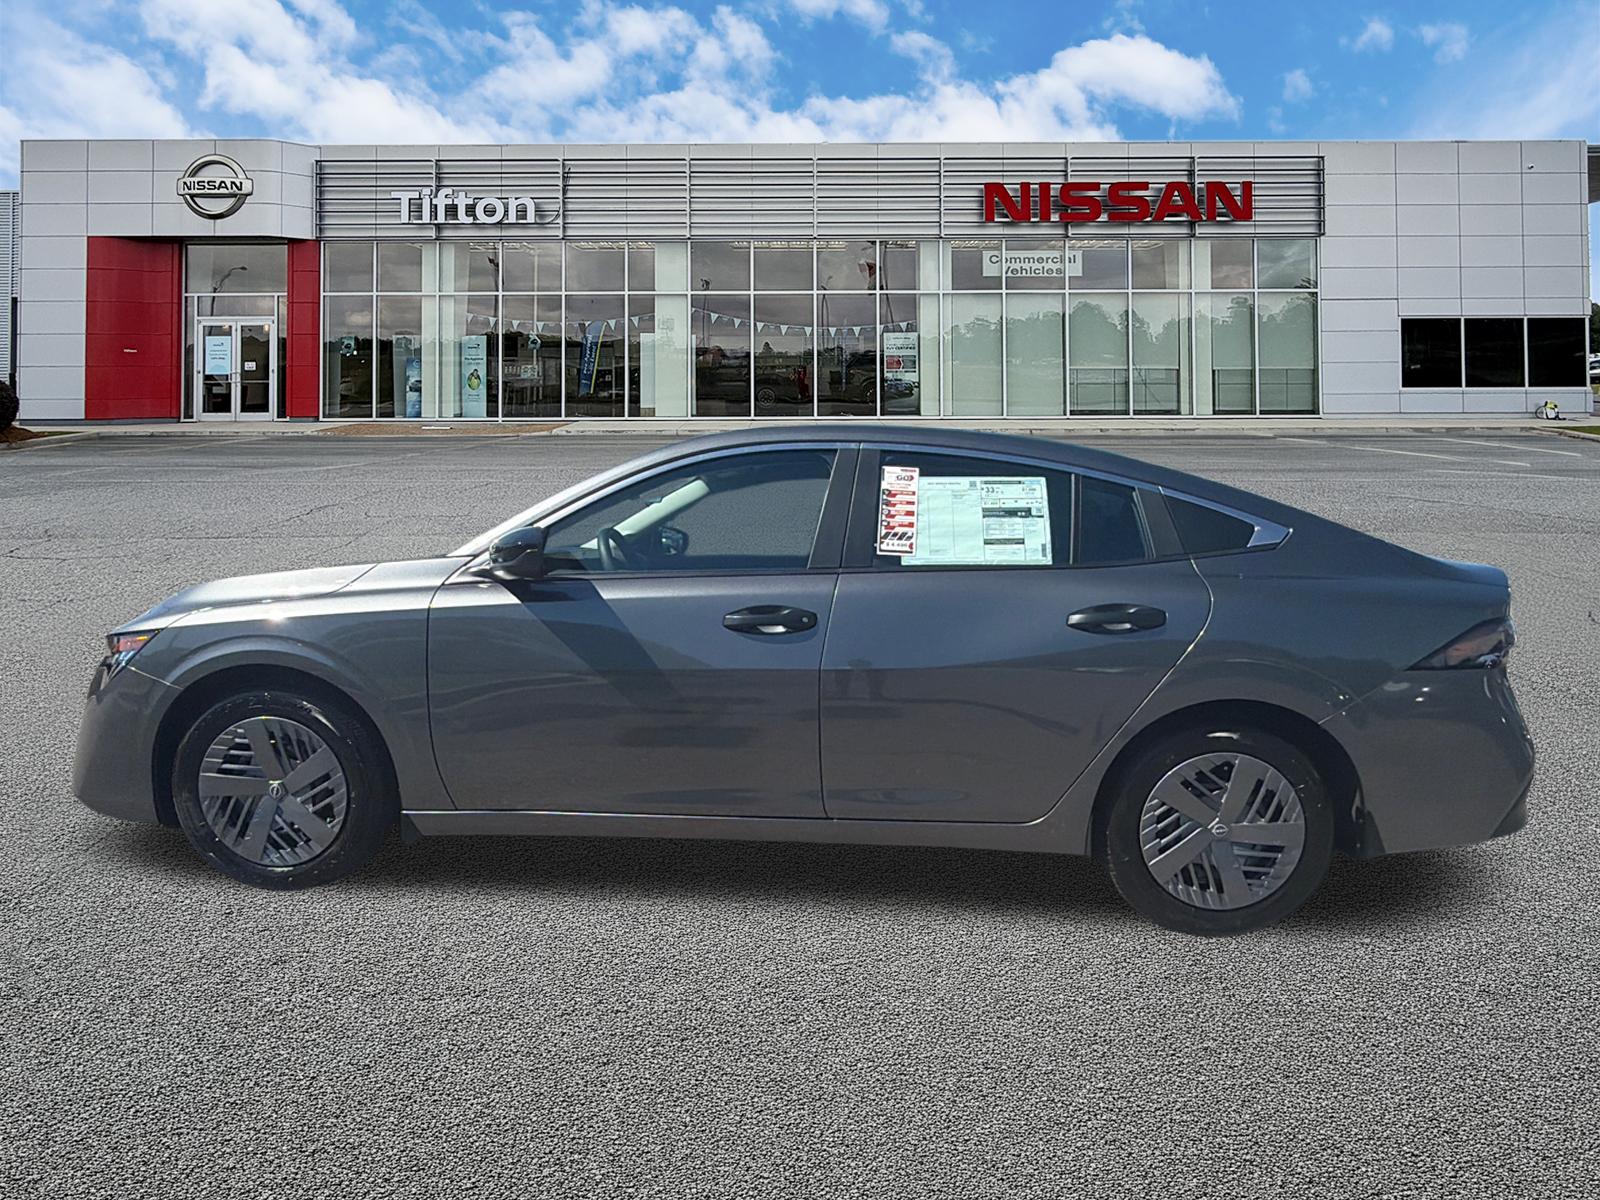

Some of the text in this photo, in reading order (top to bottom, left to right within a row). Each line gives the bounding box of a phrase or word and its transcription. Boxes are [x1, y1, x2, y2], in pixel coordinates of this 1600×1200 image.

[183, 181, 243, 191] NISSAN
[984, 181, 1253, 222] NISSAN
[391, 188, 536, 224] Tifton
